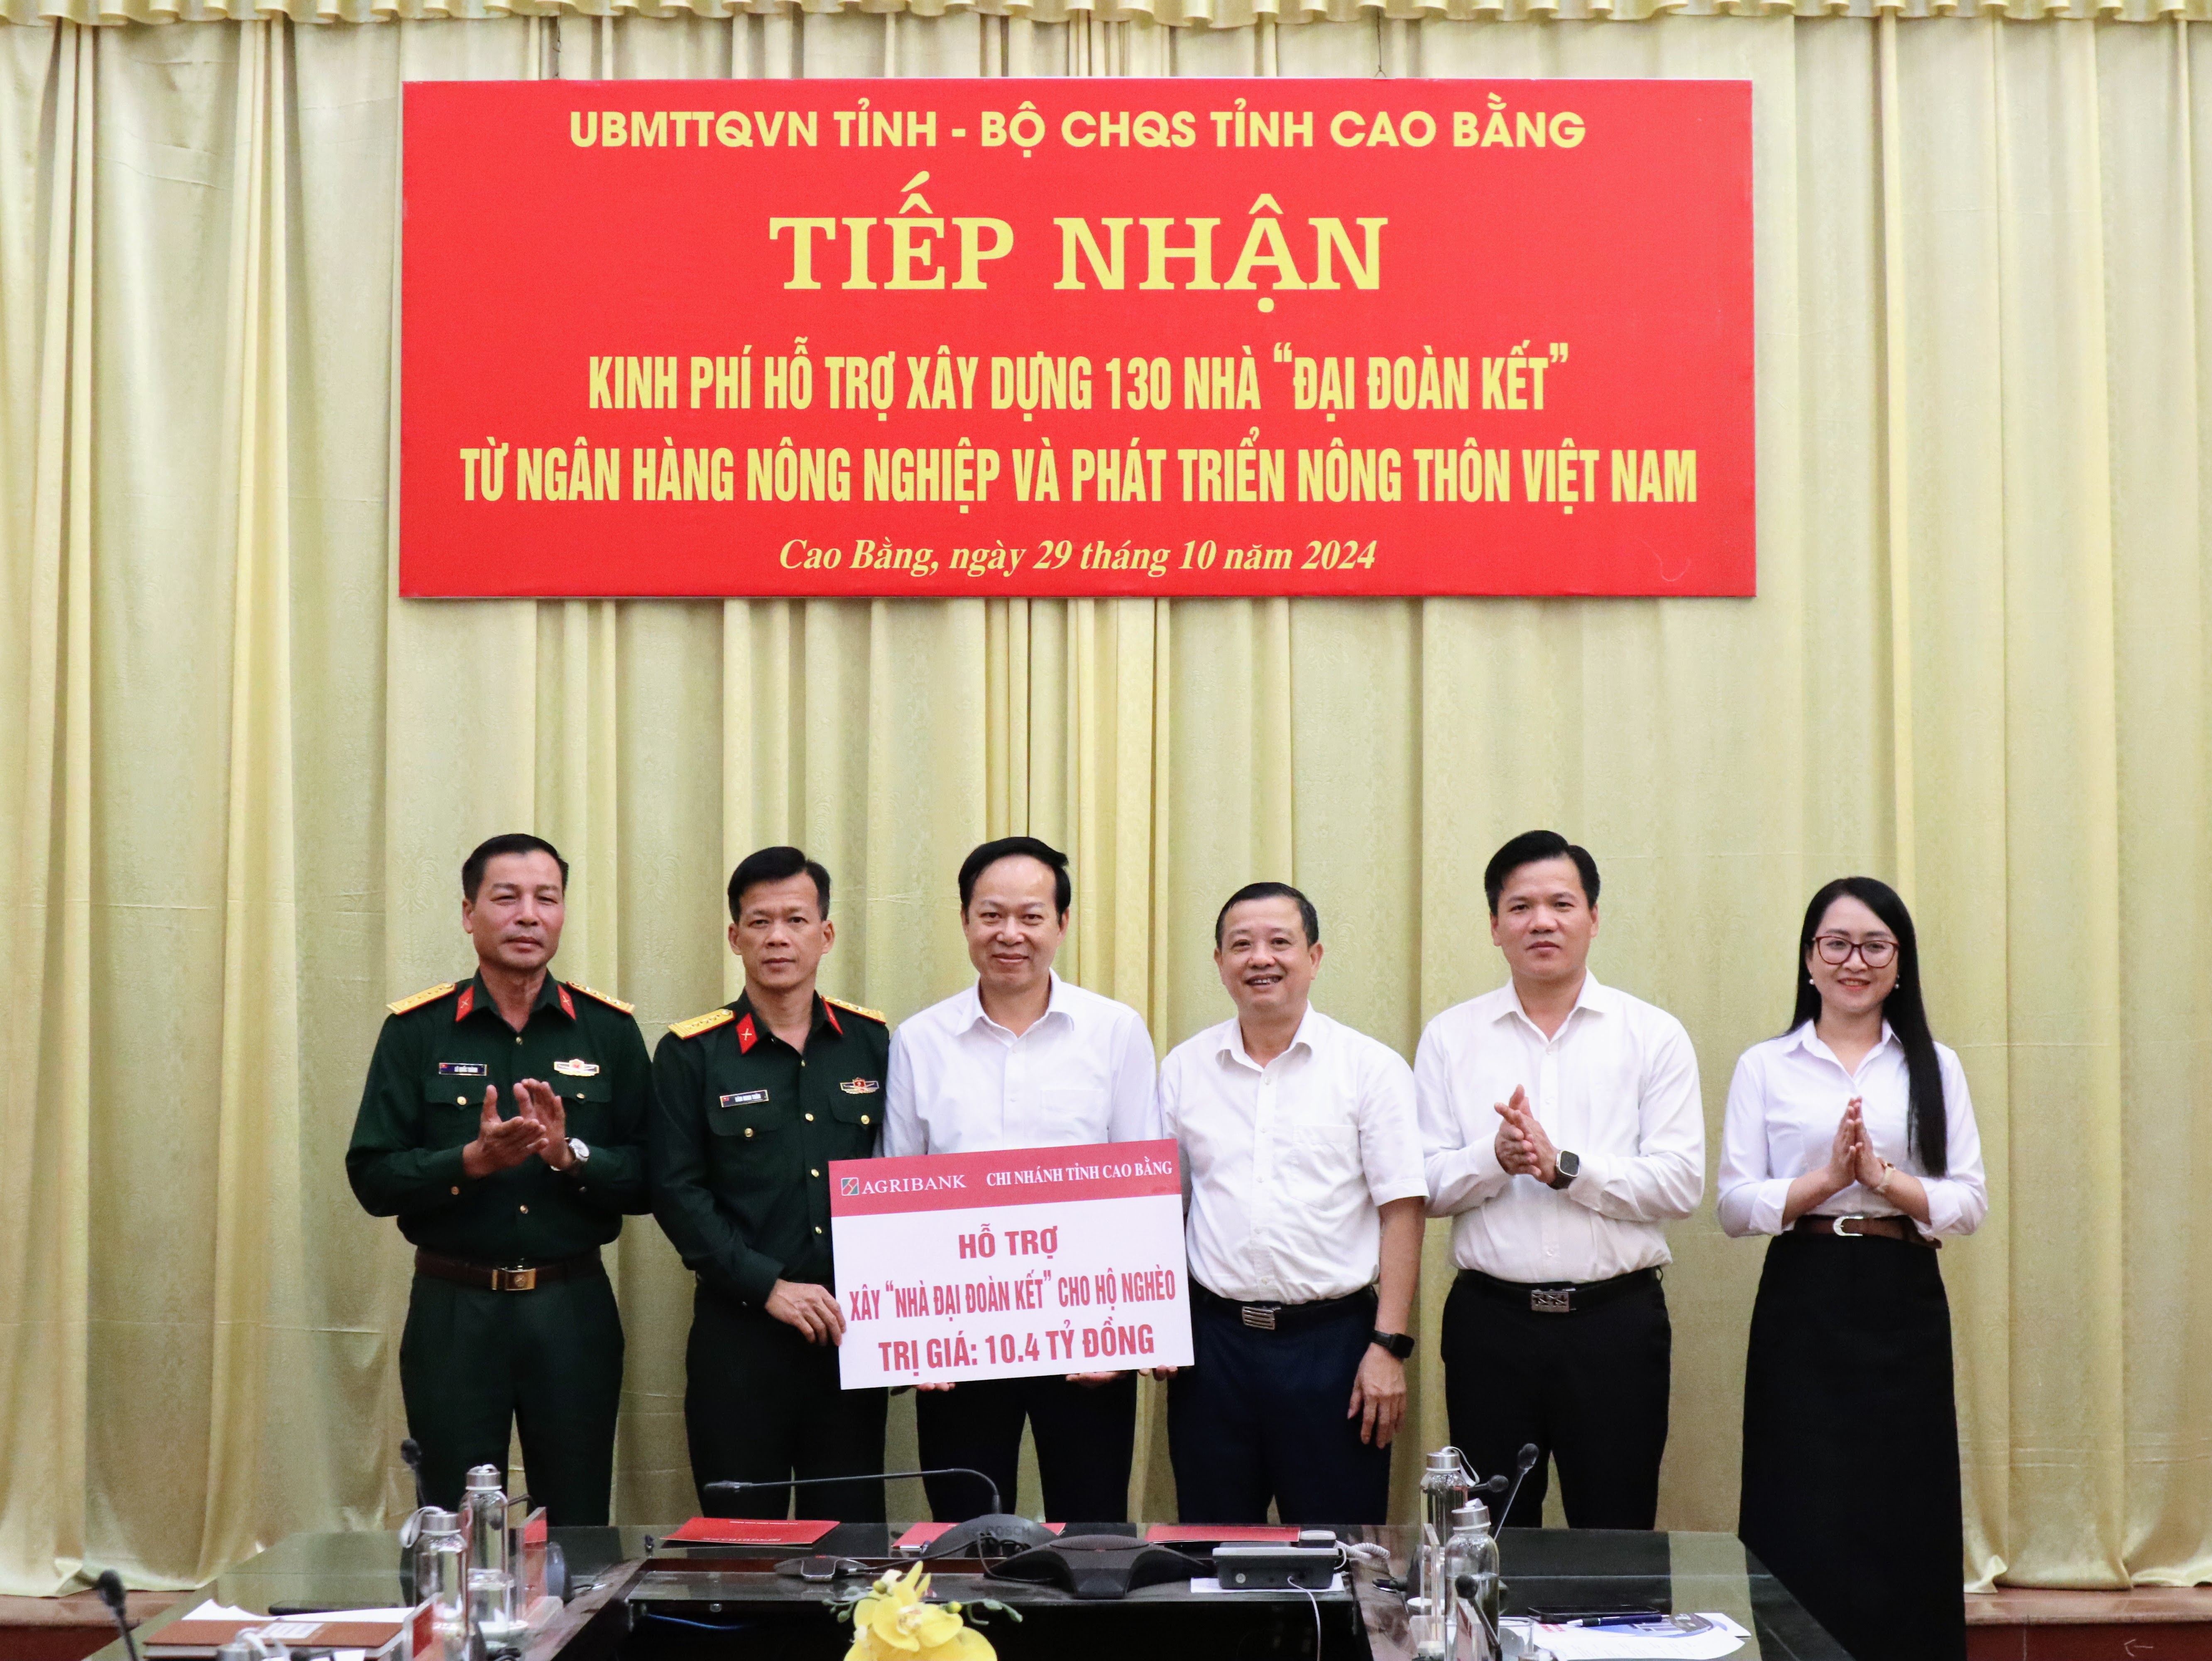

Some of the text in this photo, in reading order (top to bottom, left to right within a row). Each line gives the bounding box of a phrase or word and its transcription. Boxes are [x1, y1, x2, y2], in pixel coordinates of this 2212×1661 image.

[571, 111, 817, 147] UBMTTQVN
[834, 98, 936, 146] TỈNH
[982, 101, 1045, 157] BỘ
[1062, 111, 1196, 147] CHQS
[1211, 98, 1313, 147] TỈNH
[1331, 111, 1436, 147] CAO
[1453, 93, 1586, 148] BẰNG
[770, 171, 1388, 312] TIẾP NHẬN
[590, 357, 677, 408] KINH
[691, 345, 751, 408] PHÍ
[765, 337, 812, 409] HỖ
[825, 351, 895, 421] TRỢ
[907, 345, 978, 409] XÂY
[992, 351, 1091, 421] DỰNG
[1106, 357, 1171, 410] 130
[1184, 345, 1260, 409] NHÀ
[1367, 345, 1468, 409] ĐOÀN
[460, 426, 1696, 514] TỪ NGÂN HÀNG NÔNG NGHIỆP VÀ PHÁT TRIỂN NÔNG THÔN VIỆT NAM
[781, 537, 1377, 577] Cao Bằng, ngày 29 tháng 10 năm 2024
[862, 1175, 967, 1194] AGRIBANK
[986, 1156, 1172, 1186] CHI NHÁNH TỈNH CAO BẰNG
[959, 1223, 1057, 1259] HỖ TRỢ
[849, 1284, 880, 1321] XÂY
[933, 1285, 961, 1321] ĐẠI
[966, 1276, 1010, 1313] ĐOÀN
[1058, 1276, 1090, 1307] CHO
[1095, 1267, 1116, 1311] HỘ
[1121, 1264, 1175, 1303] NGHÈO
[878, 1316, 1154, 1376] TRỊ GIÁ: 10.4 TỶ ĐỒNG
